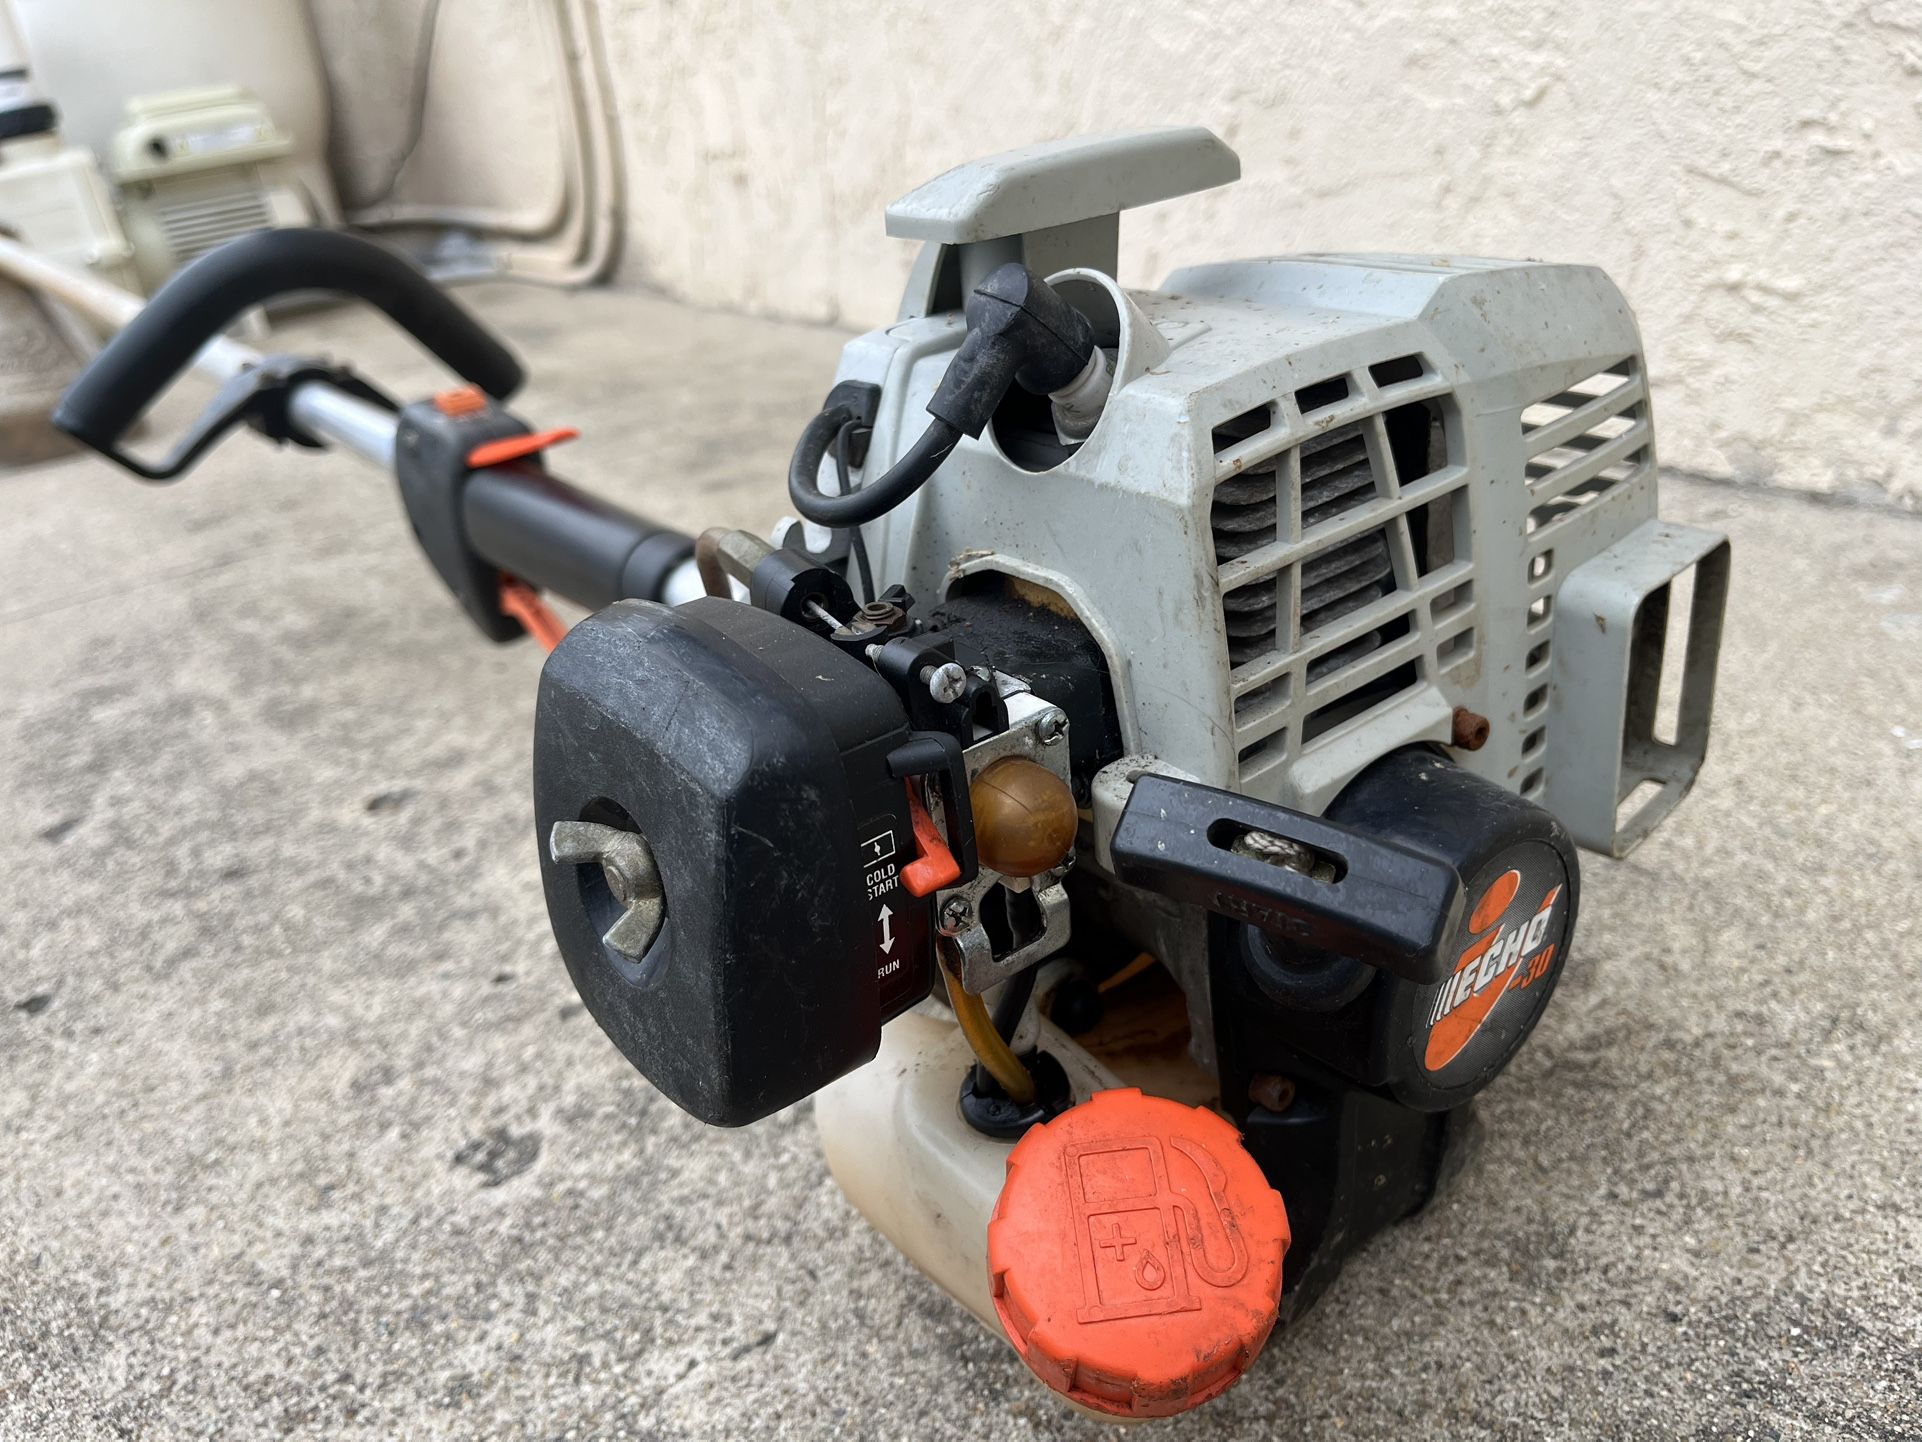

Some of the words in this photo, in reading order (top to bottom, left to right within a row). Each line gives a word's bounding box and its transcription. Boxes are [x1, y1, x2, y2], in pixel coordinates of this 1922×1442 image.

[866, 863, 896, 886] COLD
[867, 875, 899, 901] START
[877, 958, 900, 979] RUN
[1453, 906, 1552, 1008] ECHO
